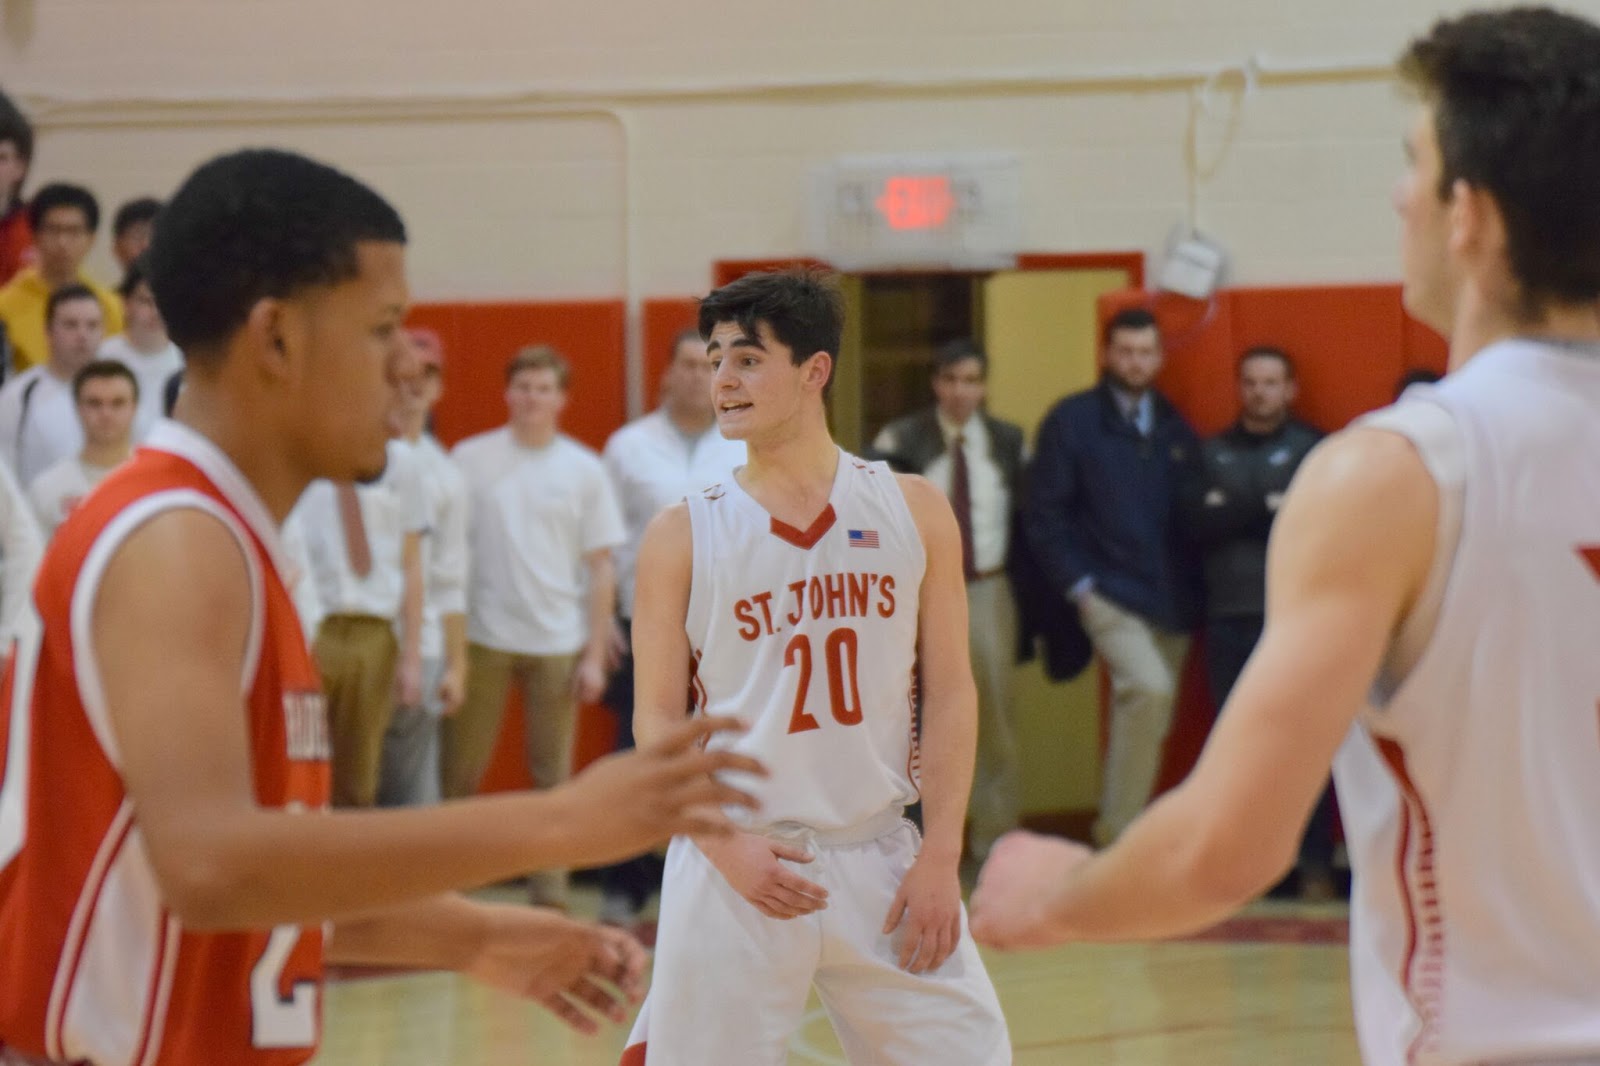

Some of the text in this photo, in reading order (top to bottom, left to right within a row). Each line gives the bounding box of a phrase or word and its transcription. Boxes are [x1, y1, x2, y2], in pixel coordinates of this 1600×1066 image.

[733, 572, 896, 642] ST. JOHN'S
[784, 627, 864, 735] 20
